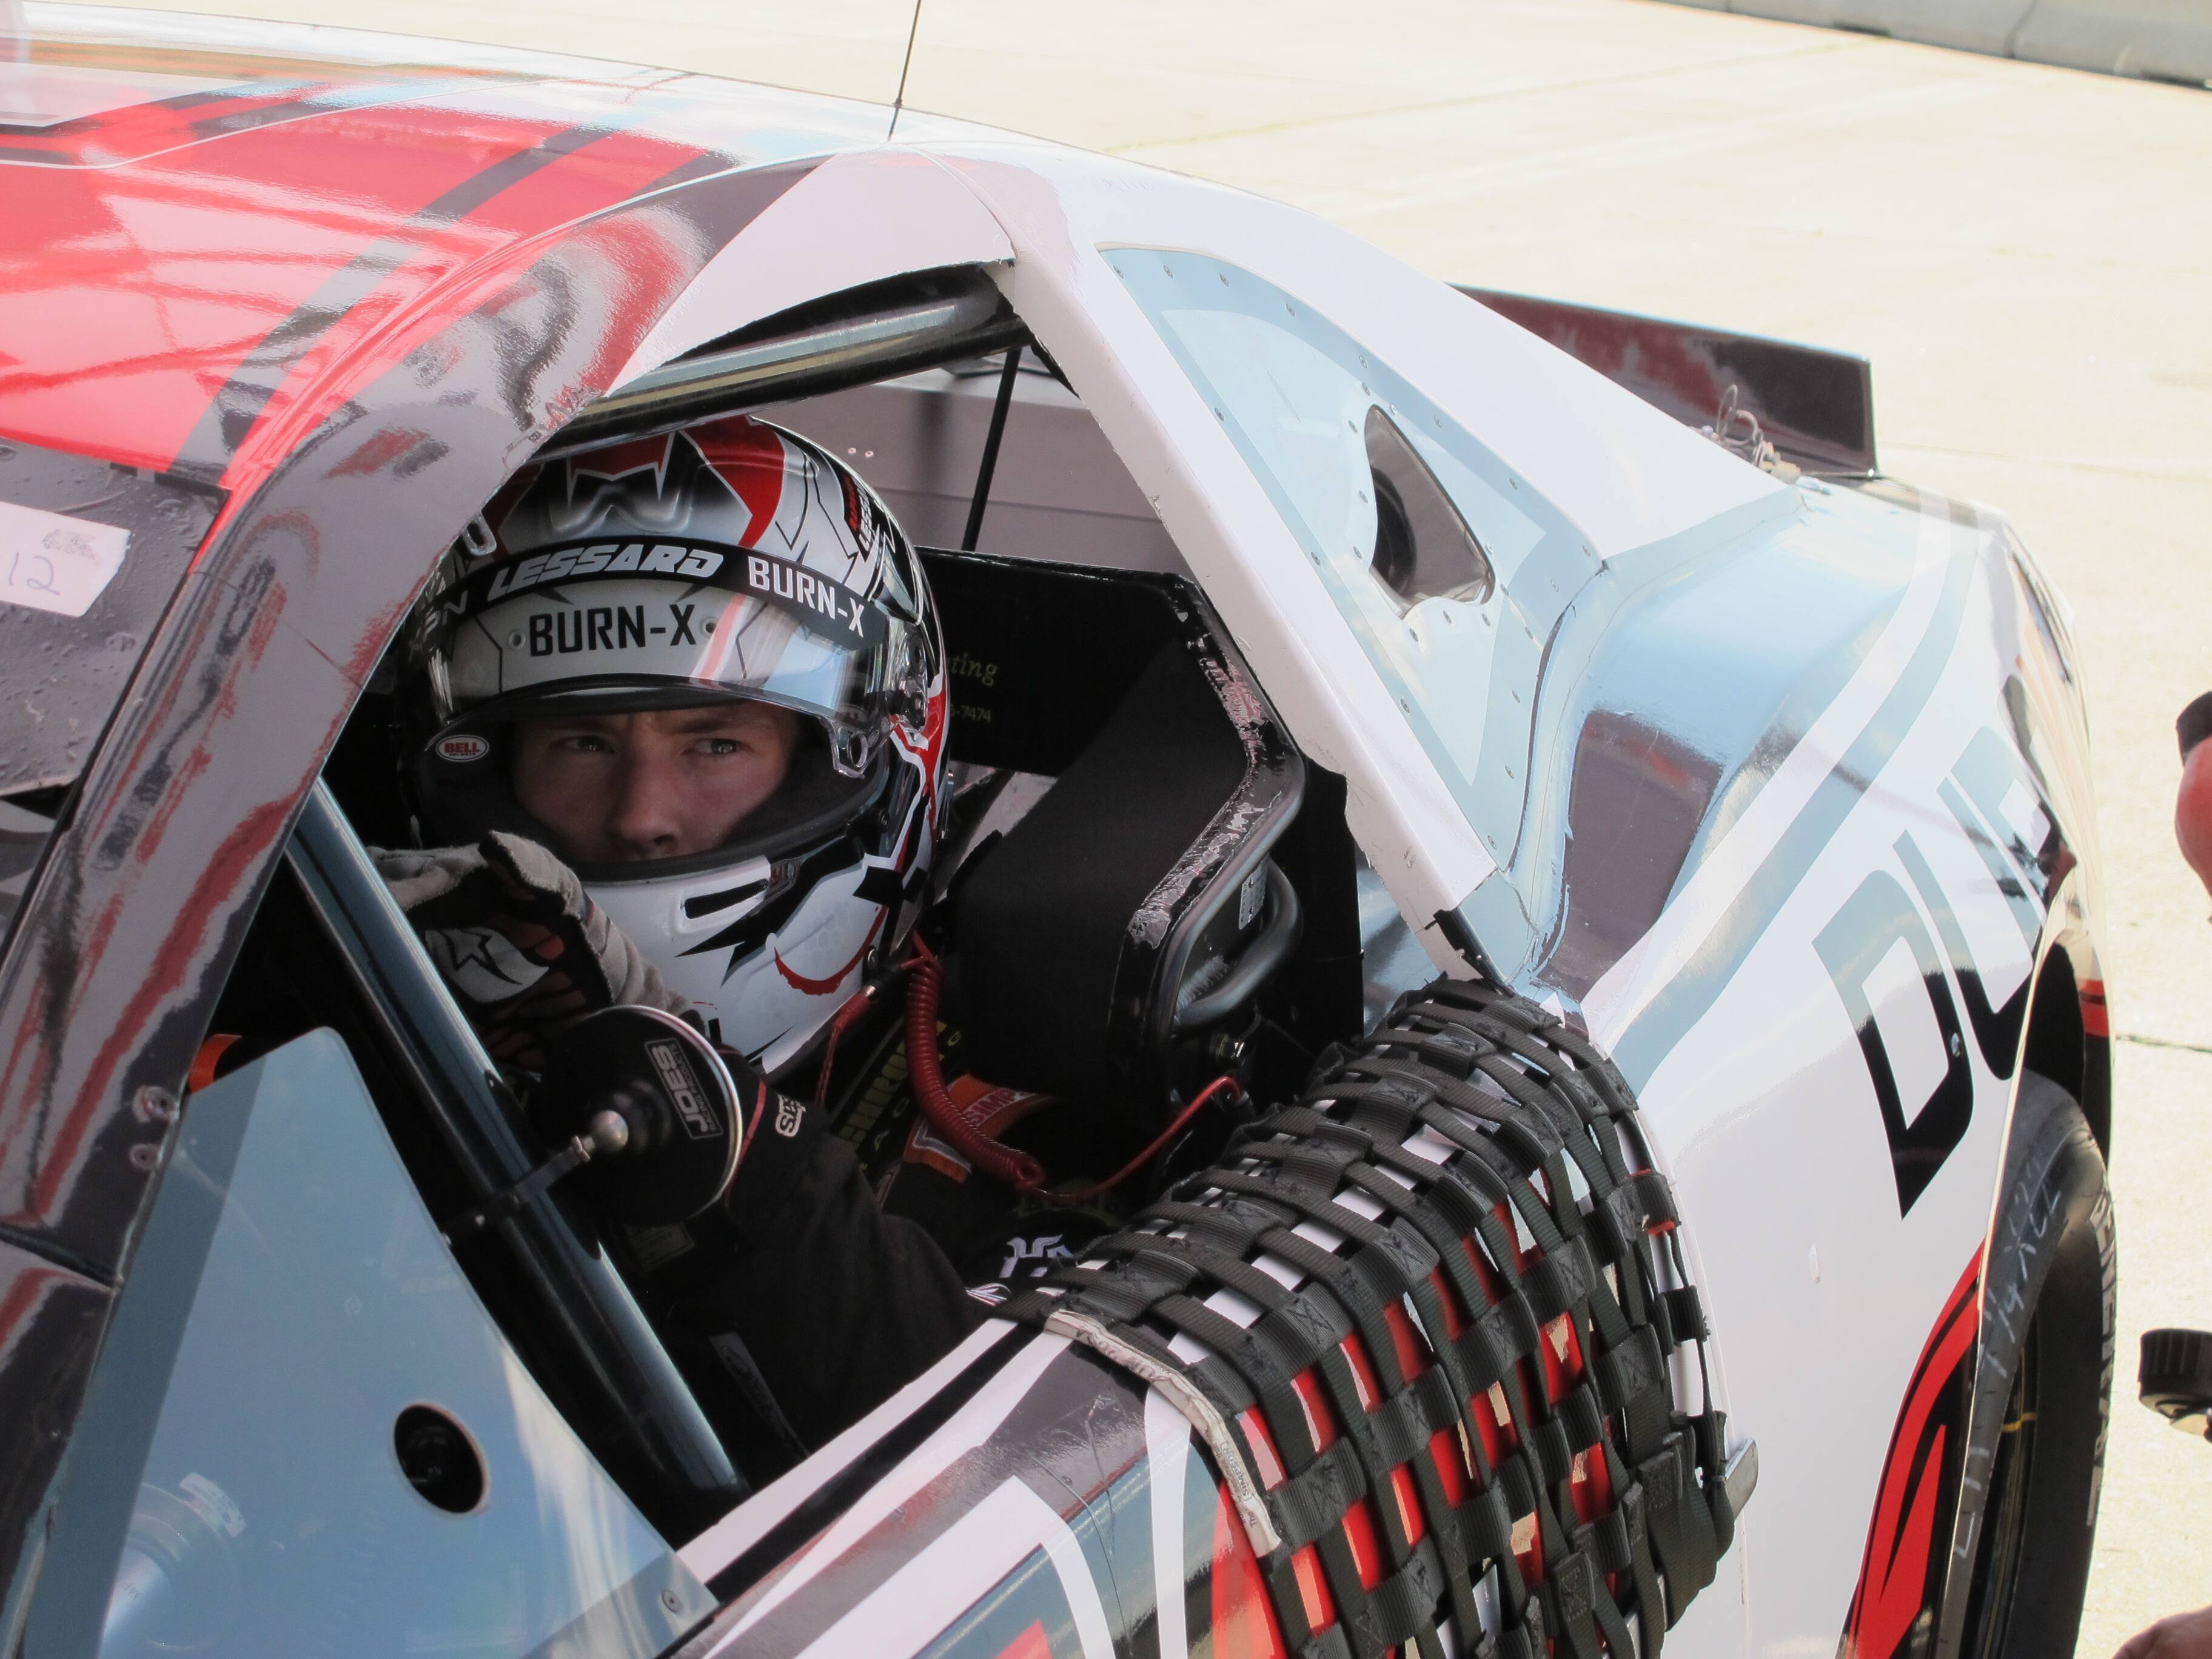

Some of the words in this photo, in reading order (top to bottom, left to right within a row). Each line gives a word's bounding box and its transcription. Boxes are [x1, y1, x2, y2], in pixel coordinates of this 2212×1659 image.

[487, 544, 723, 602] LESSARD
[748, 556, 865, 637] BURN-X
[529, 604, 697, 657] BURN-X
[445, 742, 480, 752] BELL
[652, 1045, 708, 1132] JOES
